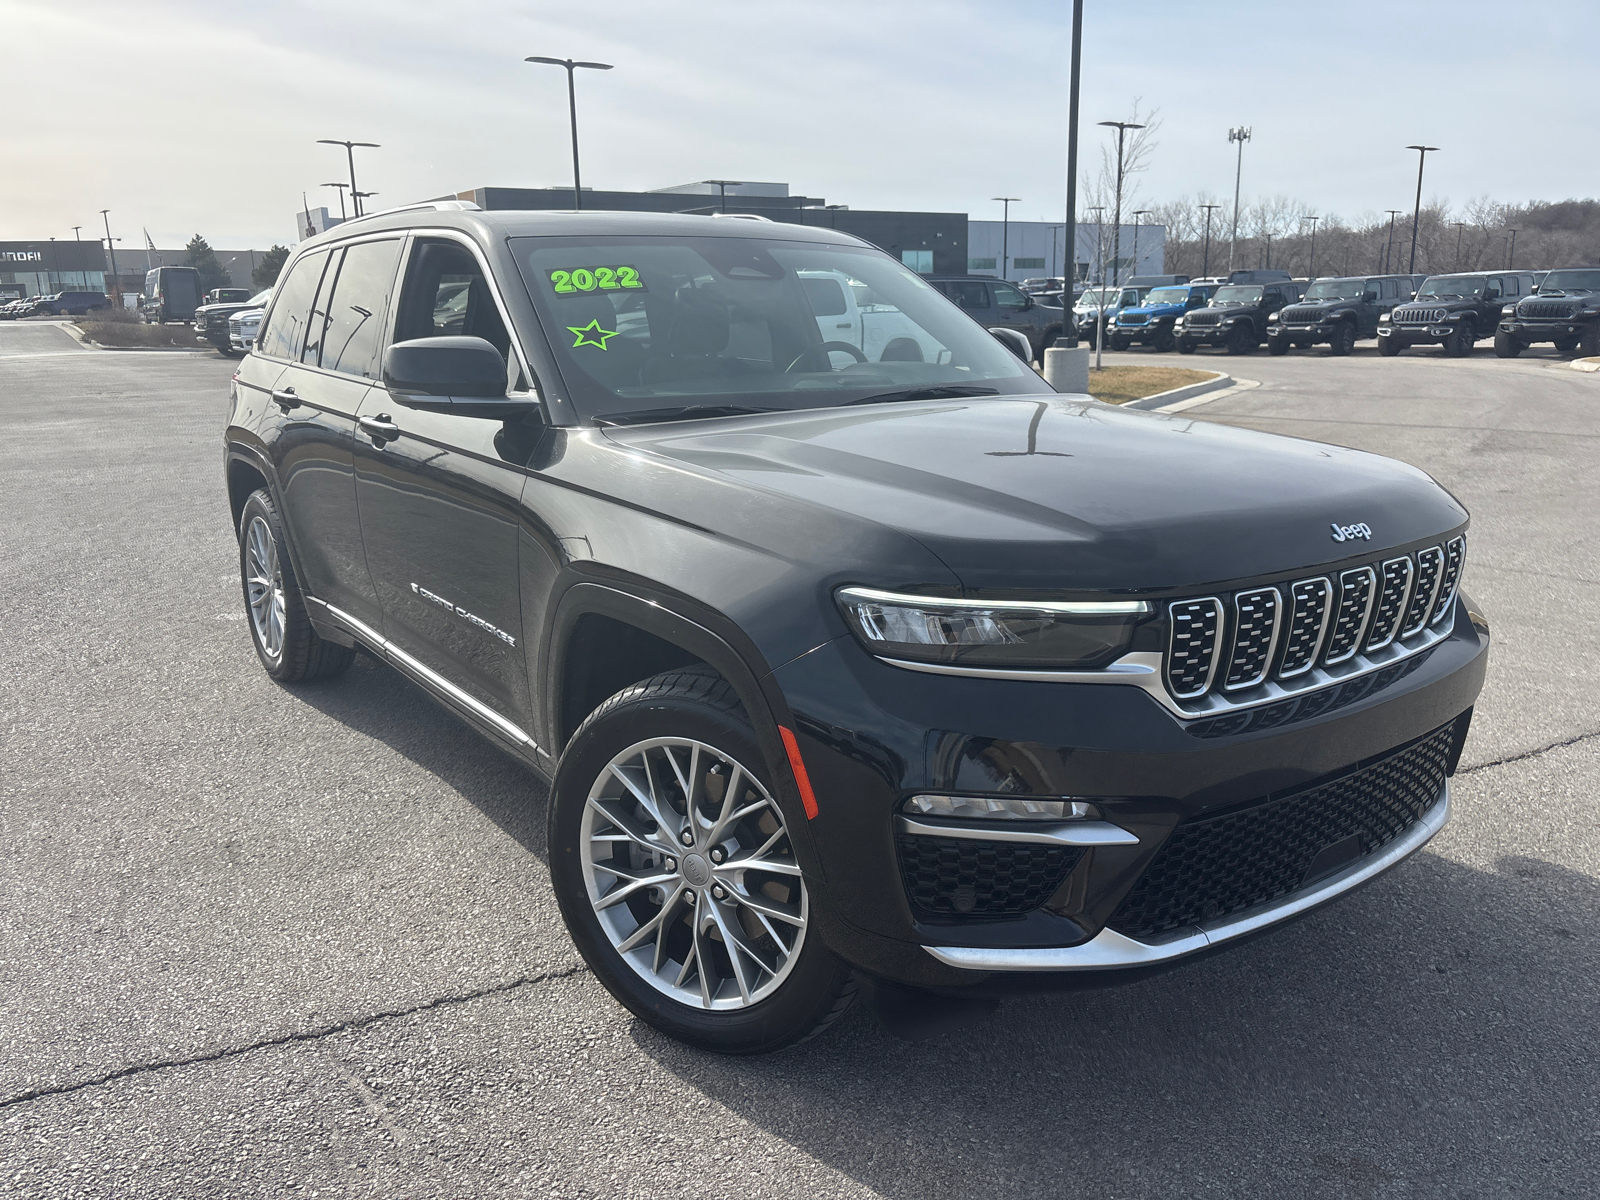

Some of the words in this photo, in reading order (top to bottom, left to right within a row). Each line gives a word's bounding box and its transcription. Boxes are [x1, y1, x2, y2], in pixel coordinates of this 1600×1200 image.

[550, 266, 643, 294] 2022
[1330, 522, 1372, 543] Jeep
[687, 858, 704, 882] Jeep
